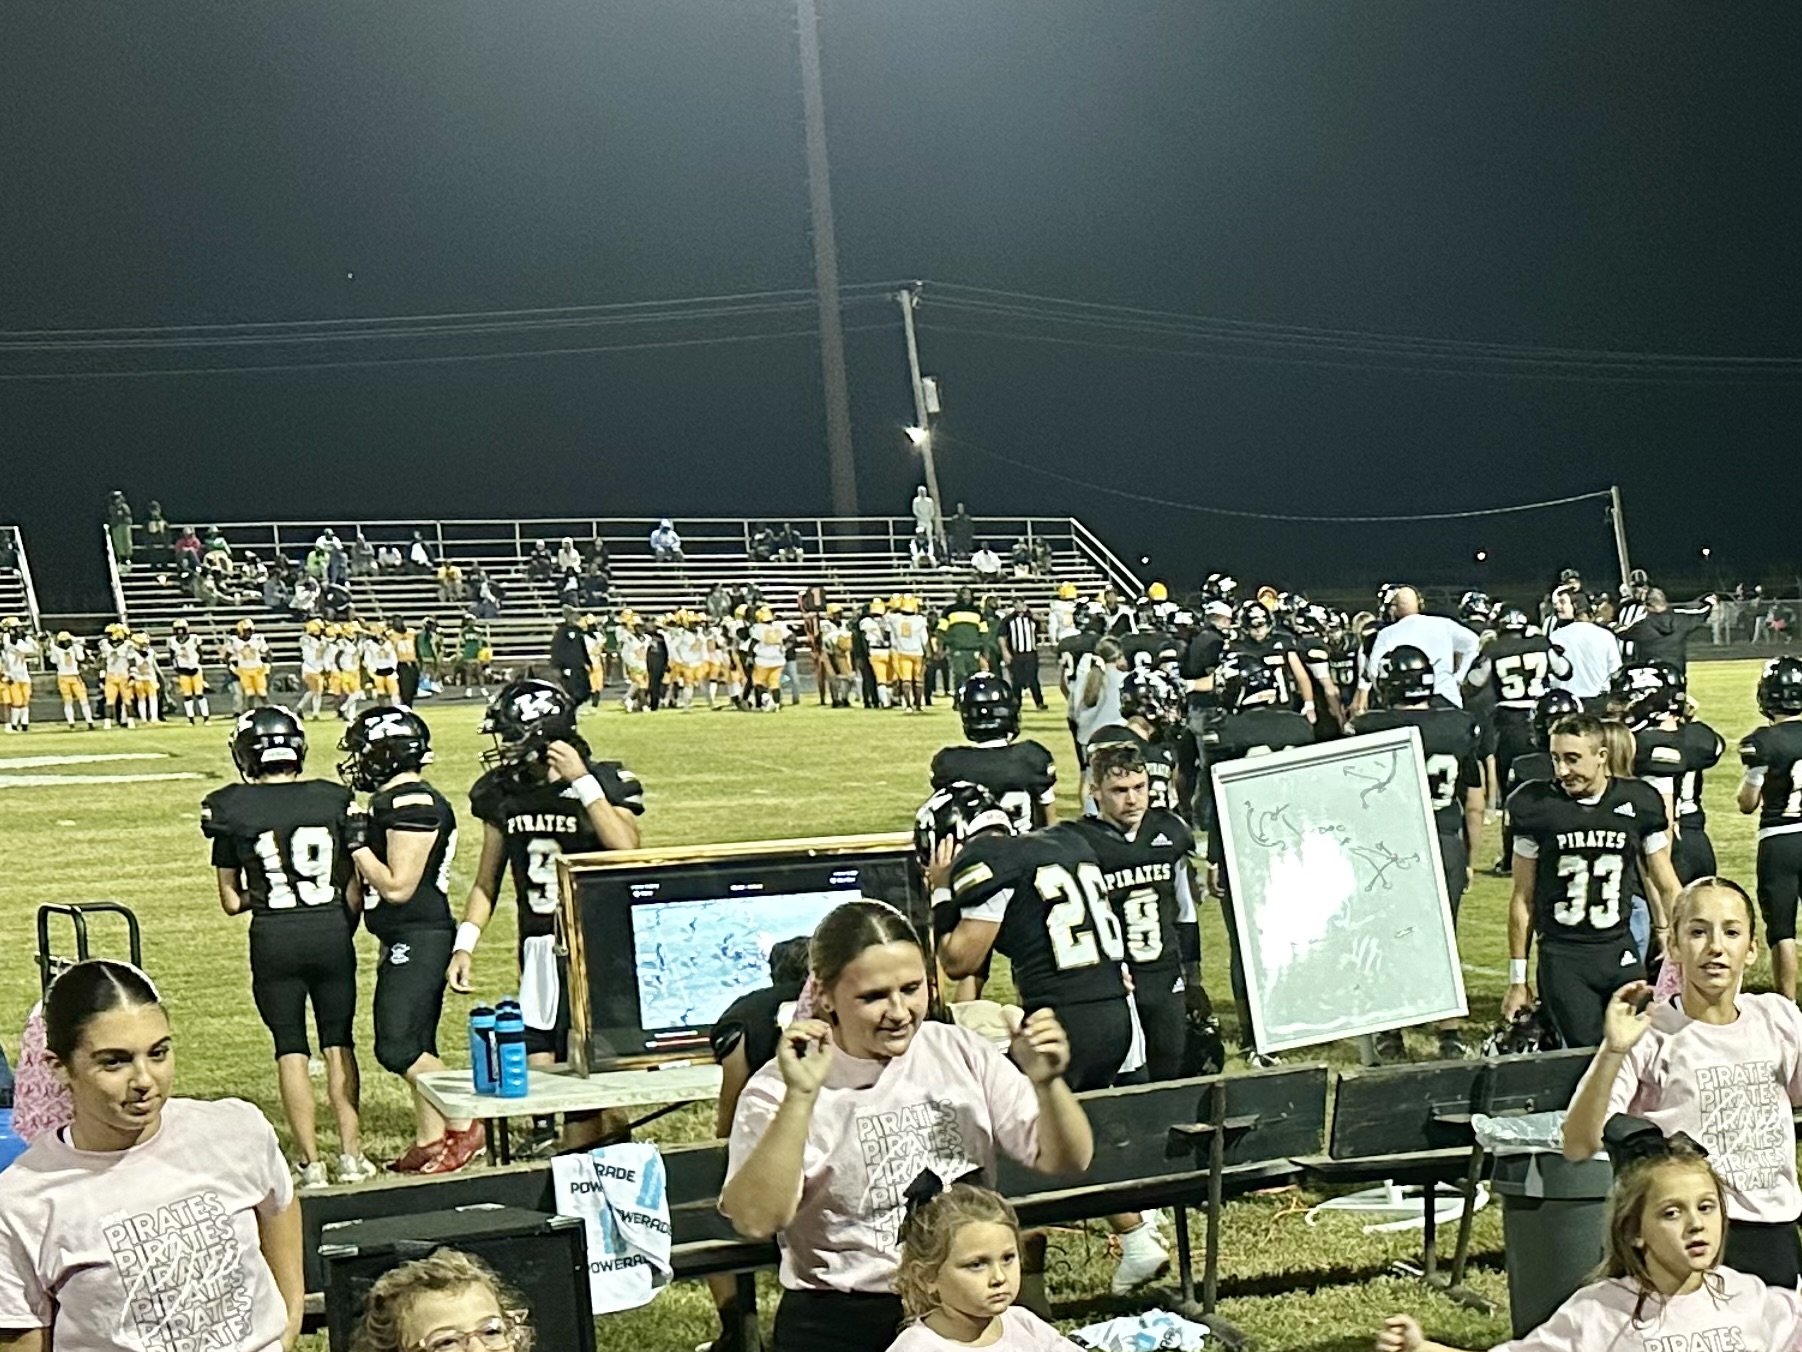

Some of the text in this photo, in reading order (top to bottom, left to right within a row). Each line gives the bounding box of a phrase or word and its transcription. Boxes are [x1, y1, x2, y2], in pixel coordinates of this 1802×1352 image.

[1495, 651, 1548, 699] 57
[1627, 667, 1664, 689] K
[507, 814, 578, 834] PIRATES
[1556, 831, 1626, 850] PIRATES
[254, 826, 335, 910] 19
[1105, 862, 1171, 891] PIRATES
[1553, 854, 1624, 930] 33
[1034, 861, 1125, 971] 26
[1696, 1060, 1777, 1090] PIRATES
[1700, 1081, 1779, 1113] PIRATES
[856, 1099, 956, 1141] PIRATES
[861, 1121, 963, 1165] PIRATES
[103, 1191, 225, 1252] PIRATES
[113, 1214, 234, 1275] PIRATES
